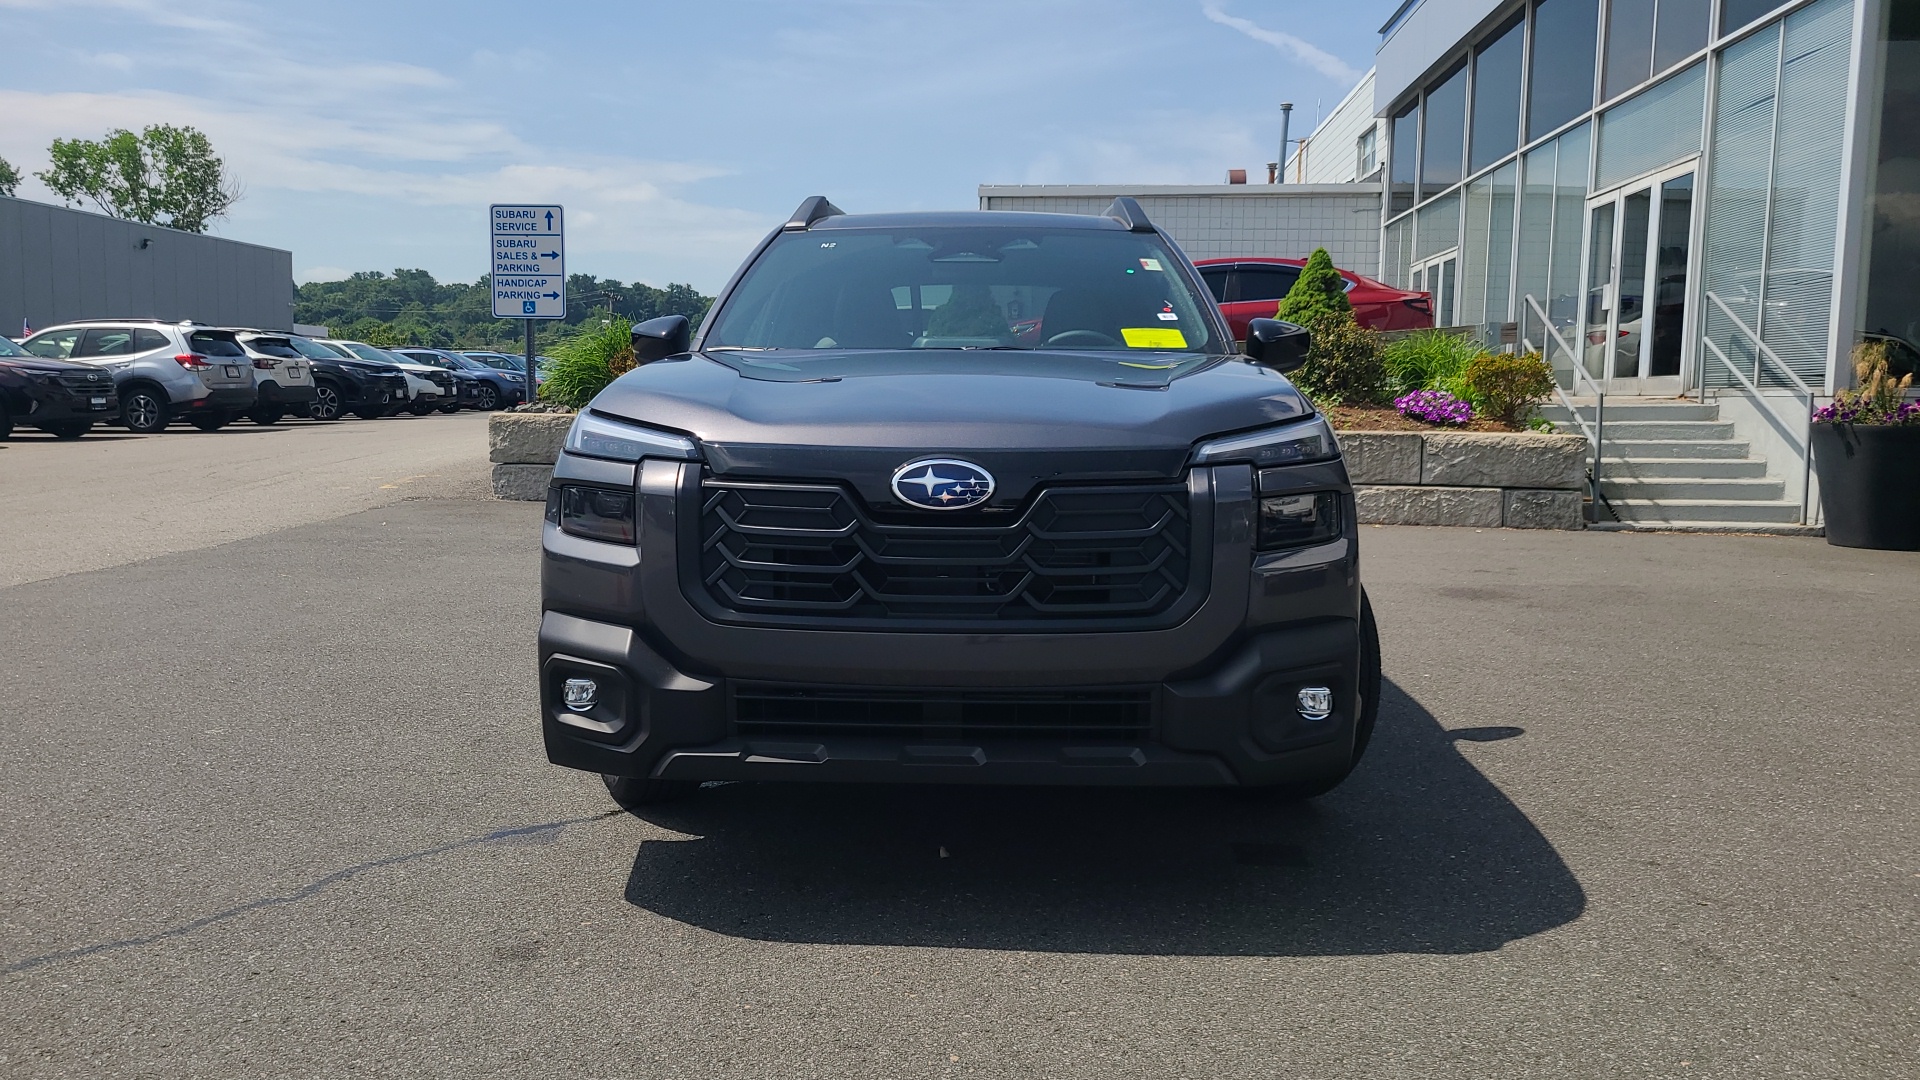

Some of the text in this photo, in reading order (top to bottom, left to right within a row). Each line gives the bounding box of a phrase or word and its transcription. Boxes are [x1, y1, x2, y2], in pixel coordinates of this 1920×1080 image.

[495, 210, 536, 219] SUBARU
[495, 222, 537, 231] SERVICE
[496, 240, 537, 248] SUBARU
[496, 251, 538, 260] SALES &
[496, 264, 540, 272] PARKING
[497, 279, 548, 287] HANDICAP
[497, 291, 541, 299] PARKING
